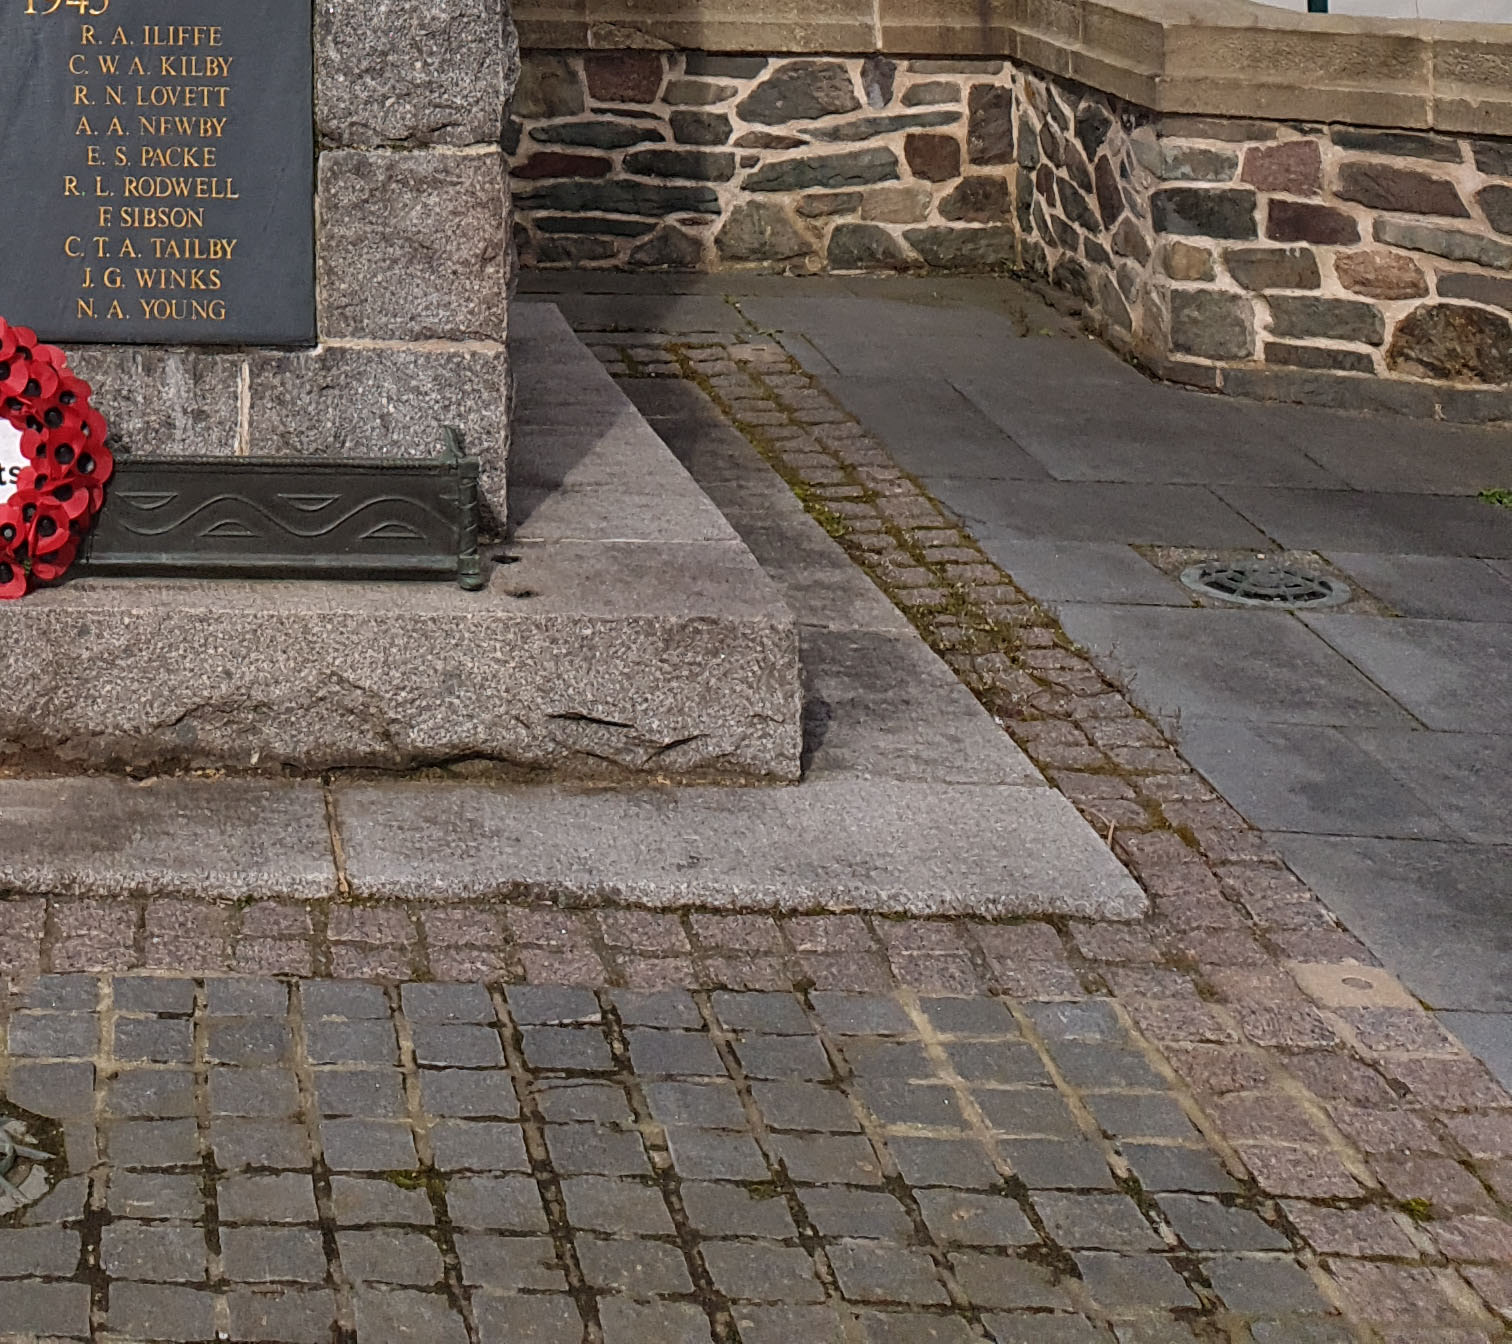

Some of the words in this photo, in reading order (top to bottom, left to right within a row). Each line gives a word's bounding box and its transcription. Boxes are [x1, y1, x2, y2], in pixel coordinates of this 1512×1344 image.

[81, 25, 103, 47] R.
[111, 25, 134, 47] A.
[144, 25, 222, 47] ILIFFE
[69, 55, 89, 77] C.
[99, 55, 119, 77] W.
[129, 55, 152, 77] A.
[162, 55, 233, 77] KILBY
[74, 86, 96, 108] R.
[106, 86, 126, 108] N.
[137, 86, 230, 108] LOVETT
[75, 116, 98, 138] A.
[107, 116, 130, 138] A.
[139, 116, 227, 138] NEWBY
[88, 146, 106, 168] E.
[115, 146, 131, 168] S.
[141, 146, 216, 168] PACKE
[64, 176, 86, 199] R.
[96, 176, 114, 199] L.
[124, 176, 239, 199] RODWELL
[99, 207, 112, 229] F.
[120, 207, 204, 229] SIBSON
[64, 237, 85, 260] C.
[93, 237, 110, 260] T.
[120, 237, 142, 260] A.
[150, 237, 237, 260] TAILBY
[82, 268, 95, 290] J.
[104, 268, 125, 290] G.
[136, 268, 222, 290] WINKS
[77, 299, 98, 321] N.
[107, 299, 130, 321] A.
[141, 299, 226, 321] YOUNG
